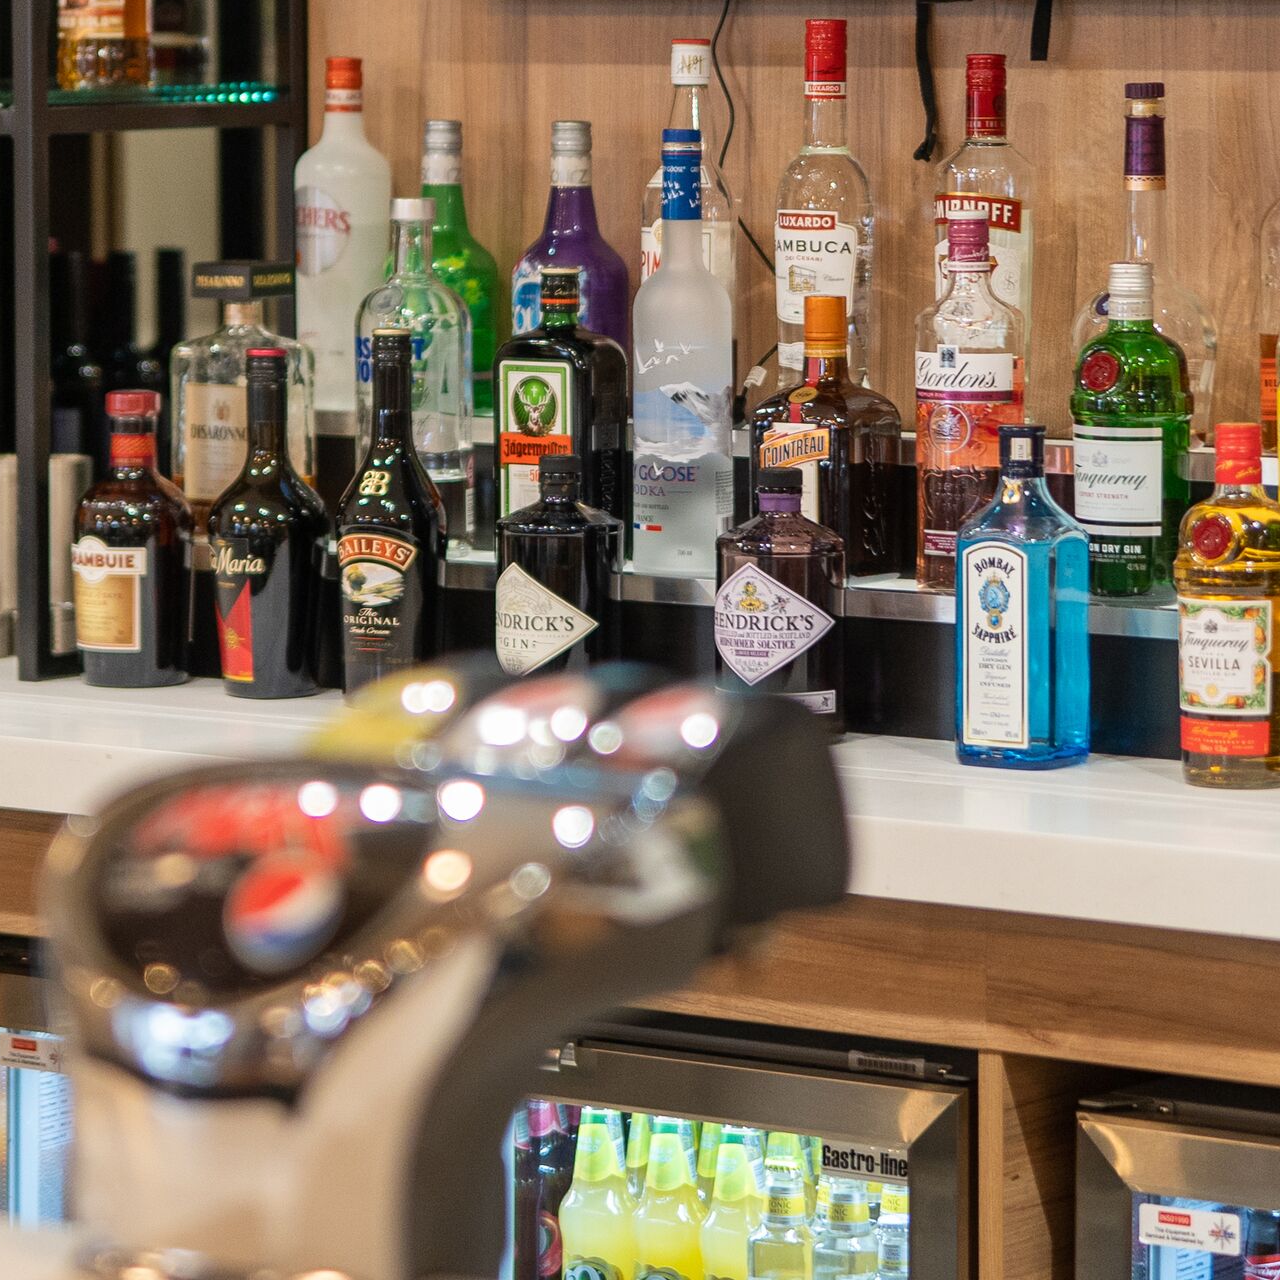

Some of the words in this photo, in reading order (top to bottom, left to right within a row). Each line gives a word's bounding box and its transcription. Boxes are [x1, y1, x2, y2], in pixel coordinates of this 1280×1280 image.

[779, 214, 833, 229] LUXARDO
[776, 238, 852, 255] AMBUCA
[763, 435, 824, 467] COINTREAU
[639, 464, 697, 482] GOOSE
[337, 538, 408, 562] BAILEYS
[1101, 543, 1120, 553] DRY
[1123, 544, 1142, 554] GIN
[215, 546, 265, 575] Maria
[972, 556, 1016, 579] BOMBAY
[343, 614, 401, 626] ORIGINAL
[496, 612, 575, 632] NDRICK'S
[503, 637, 529, 648] GIN
[778, 631, 811, 639] SCOTLAND
[971, 623, 1018, 645] SAPPHIRE
[1184, 631, 1250, 653] Tanqueray
[757, 639, 796, 649] SOLSTICE
[1188, 655, 1241, 670] SEVILLA
[822, 1144, 908, 1178] Gastro-line
[770, 1201, 791, 1209] ONIC
